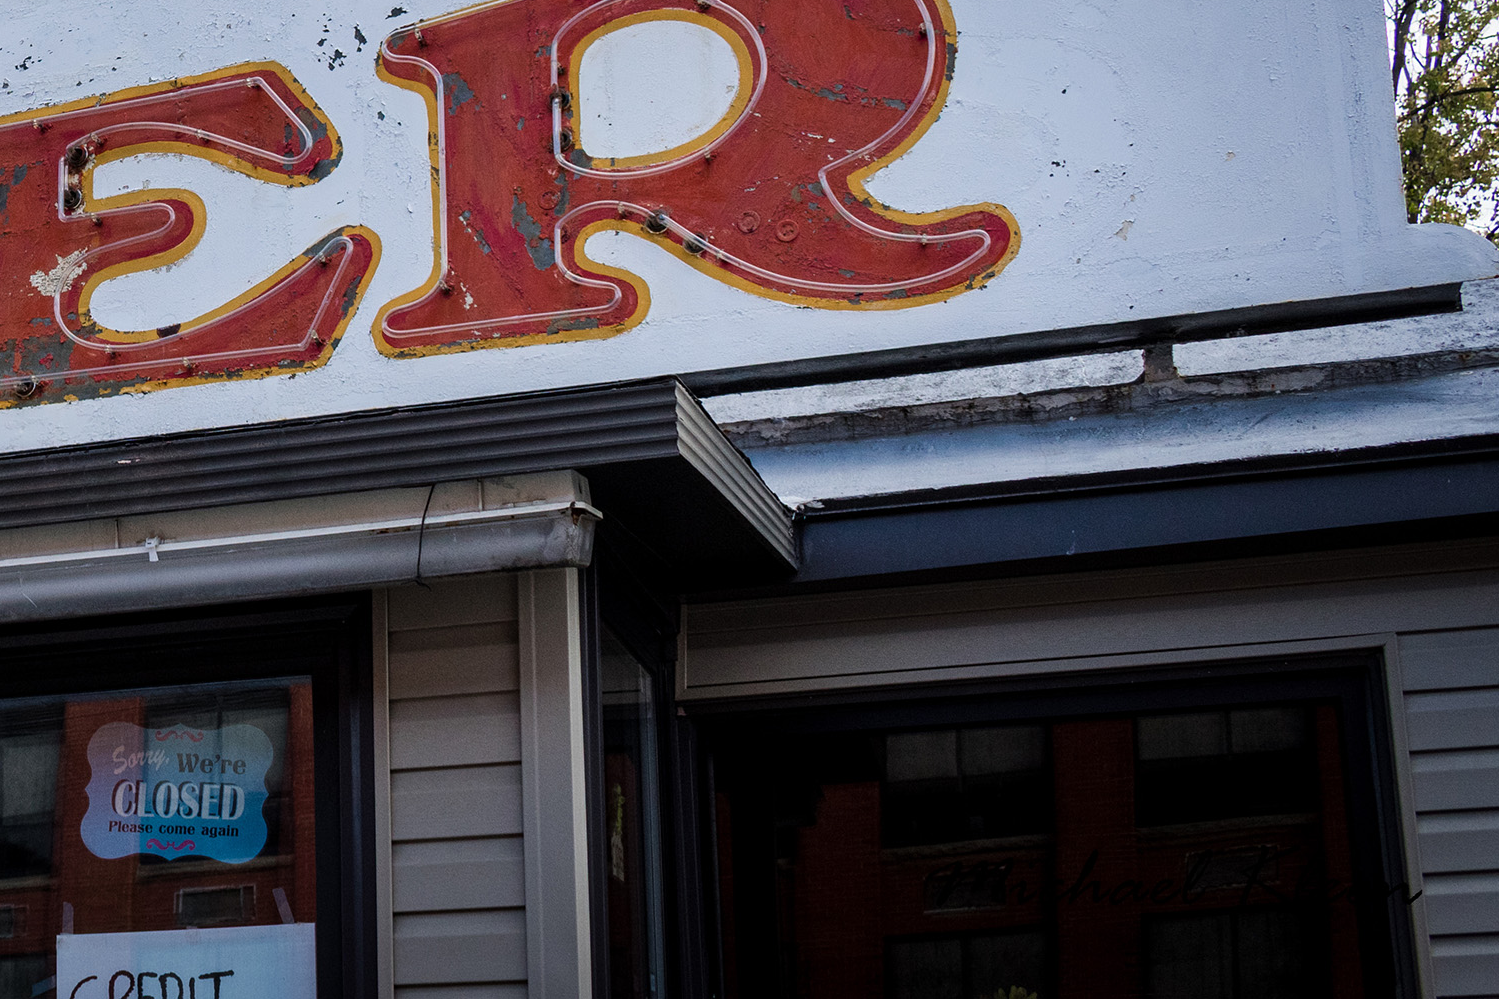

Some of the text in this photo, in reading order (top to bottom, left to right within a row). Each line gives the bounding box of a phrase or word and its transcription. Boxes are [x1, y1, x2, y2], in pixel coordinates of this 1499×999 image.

[112, 745, 247, 775] Sorry, We're
[112, 779, 245, 821] CLOSED
[108, 821, 239, 838] Please come again
